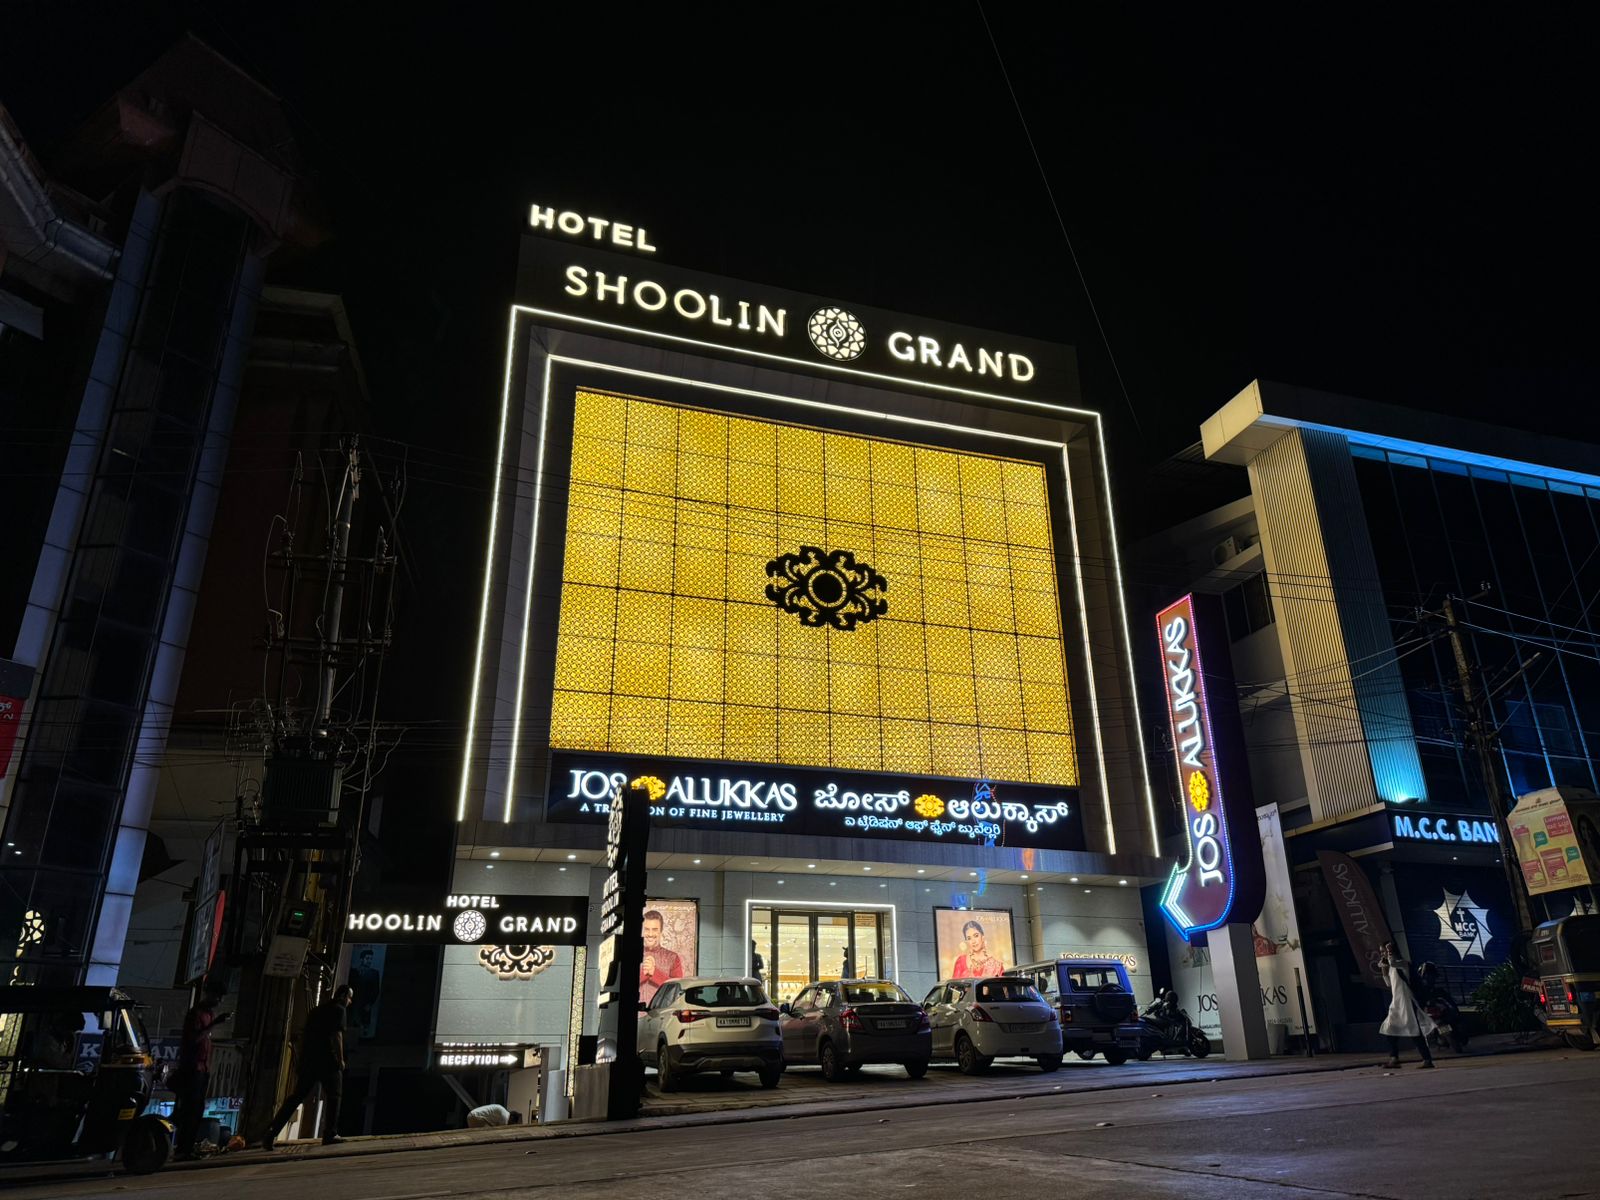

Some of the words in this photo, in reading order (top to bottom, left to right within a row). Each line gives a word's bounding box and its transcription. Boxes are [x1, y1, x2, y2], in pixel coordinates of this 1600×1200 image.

[529, 203, 657, 252] HOTEL
[564, 265, 787, 337] SHOOLIN
[887, 331, 1035, 382] GRAND
[1165, 616, 1206, 768] ALUKKAS
[567, 769, 628, 800] JOS
[665, 776, 798, 811] ALUKKAS
[814, 782, 911, 813] ಜೋಸ್
[579, 802, 590, 812] A
[669, 808, 685, 818] OF
[690, 809, 718, 819] FINE
[721, 810, 785, 822] JEWELLERY
[1394, 815, 1457, 842] M.C.C.
[1457, 818, 1501, 844] BAN
[1193, 813, 1223, 888] JOS
[446, 896, 499, 908] HOTEL
[1332, 863, 1371, 936] ALUKKAS
[348, 913, 442, 931] HOOLIN
[499, 916, 577, 933] GRAND
[1454, 921, 1477, 932] MCC
[1197, 993, 1219, 1014] JOS
[440, 1055, 499, 1066] RECEPTION
